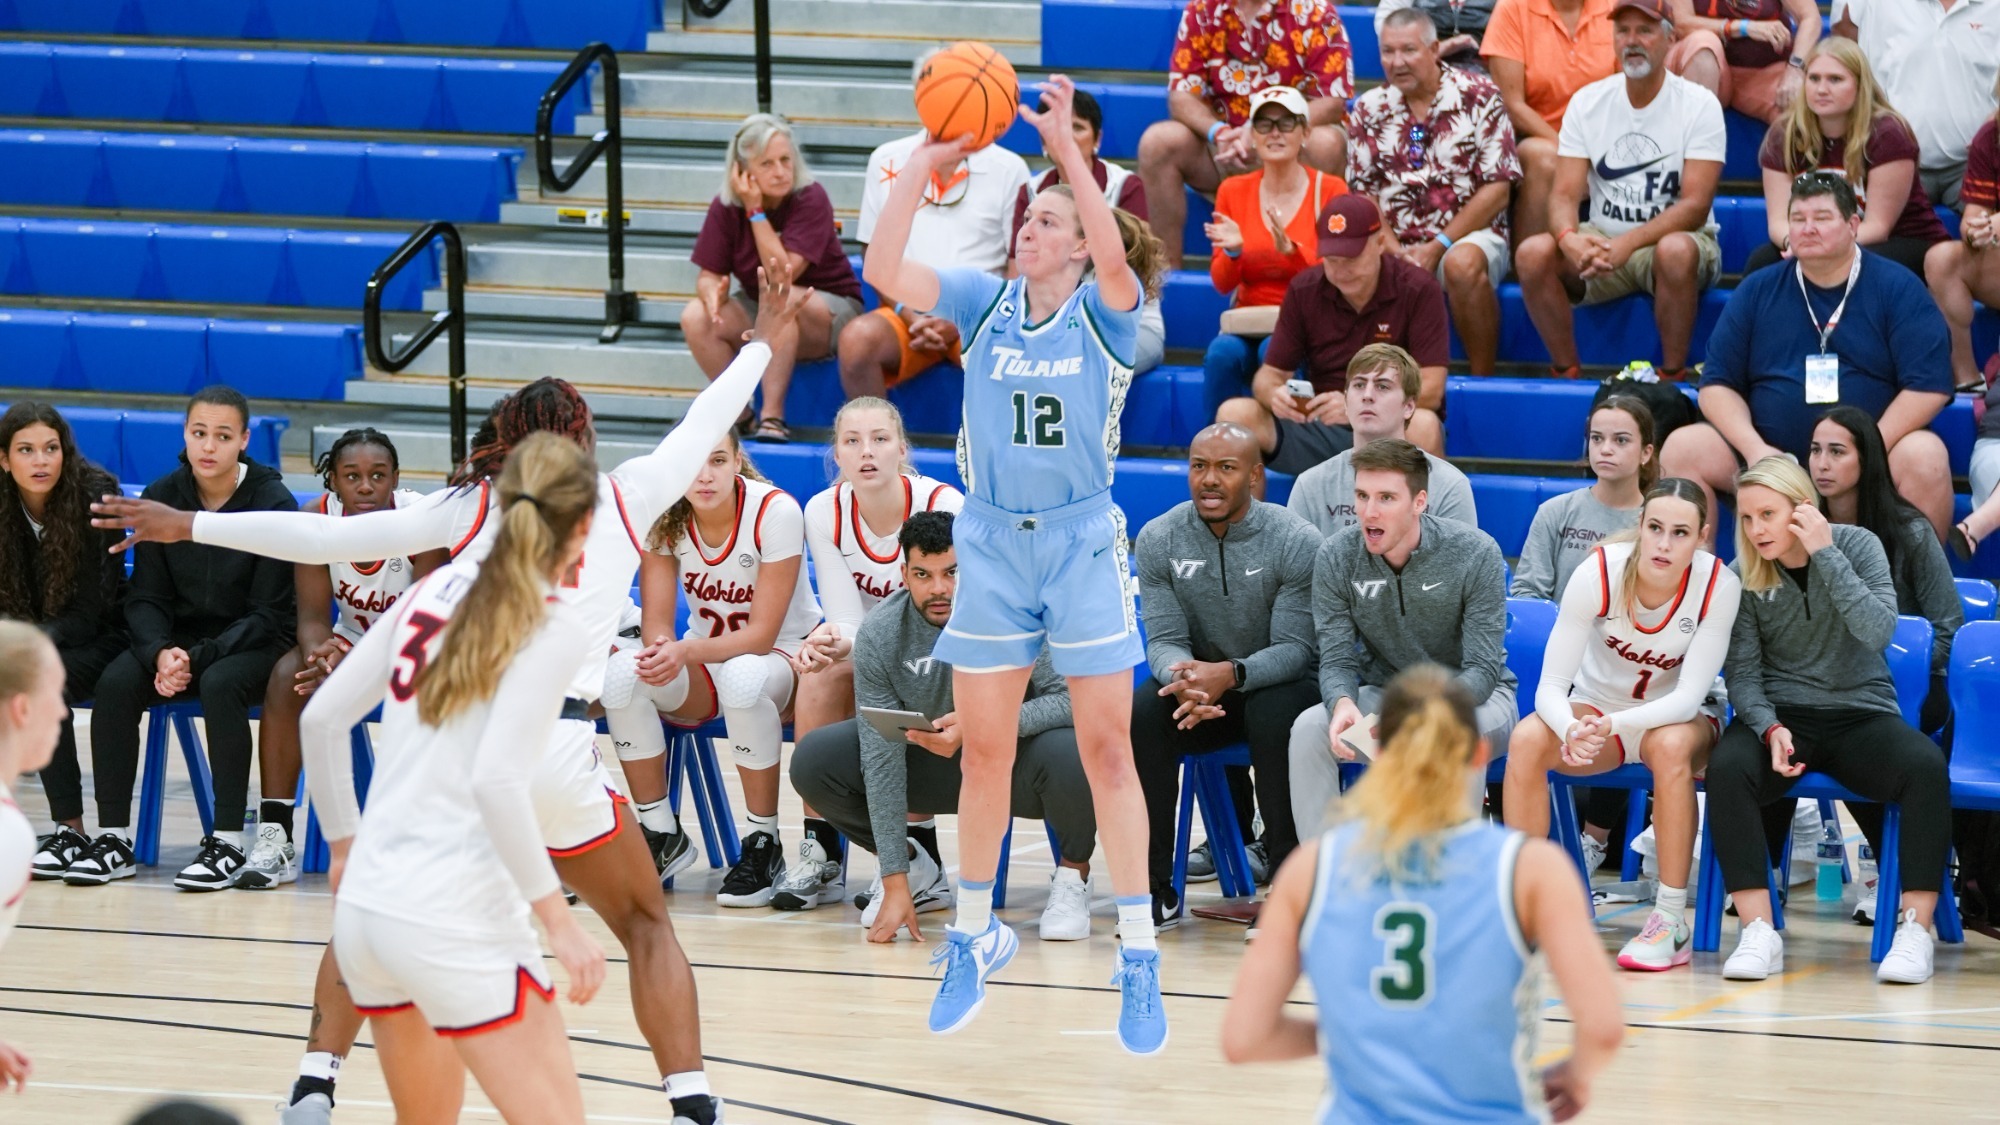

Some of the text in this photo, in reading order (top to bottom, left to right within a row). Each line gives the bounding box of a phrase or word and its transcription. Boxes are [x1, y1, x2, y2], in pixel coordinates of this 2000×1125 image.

[1644, 170, 1681, 201] F4
[999, 299, 1016, 318] C
[1378, 323, 1390, 332] VT
[1011, 390, 1066, 448] 12
[1558, 526, 1607, 542] VIRGIN
[1169, 558, 1207, 579] VT
[1351, 579, 1388, 599] VT
[902, 656, 936, 677] VT
[1632, 669, 1653, 700] 1
[1374, 905, 1434, 1007] 3
